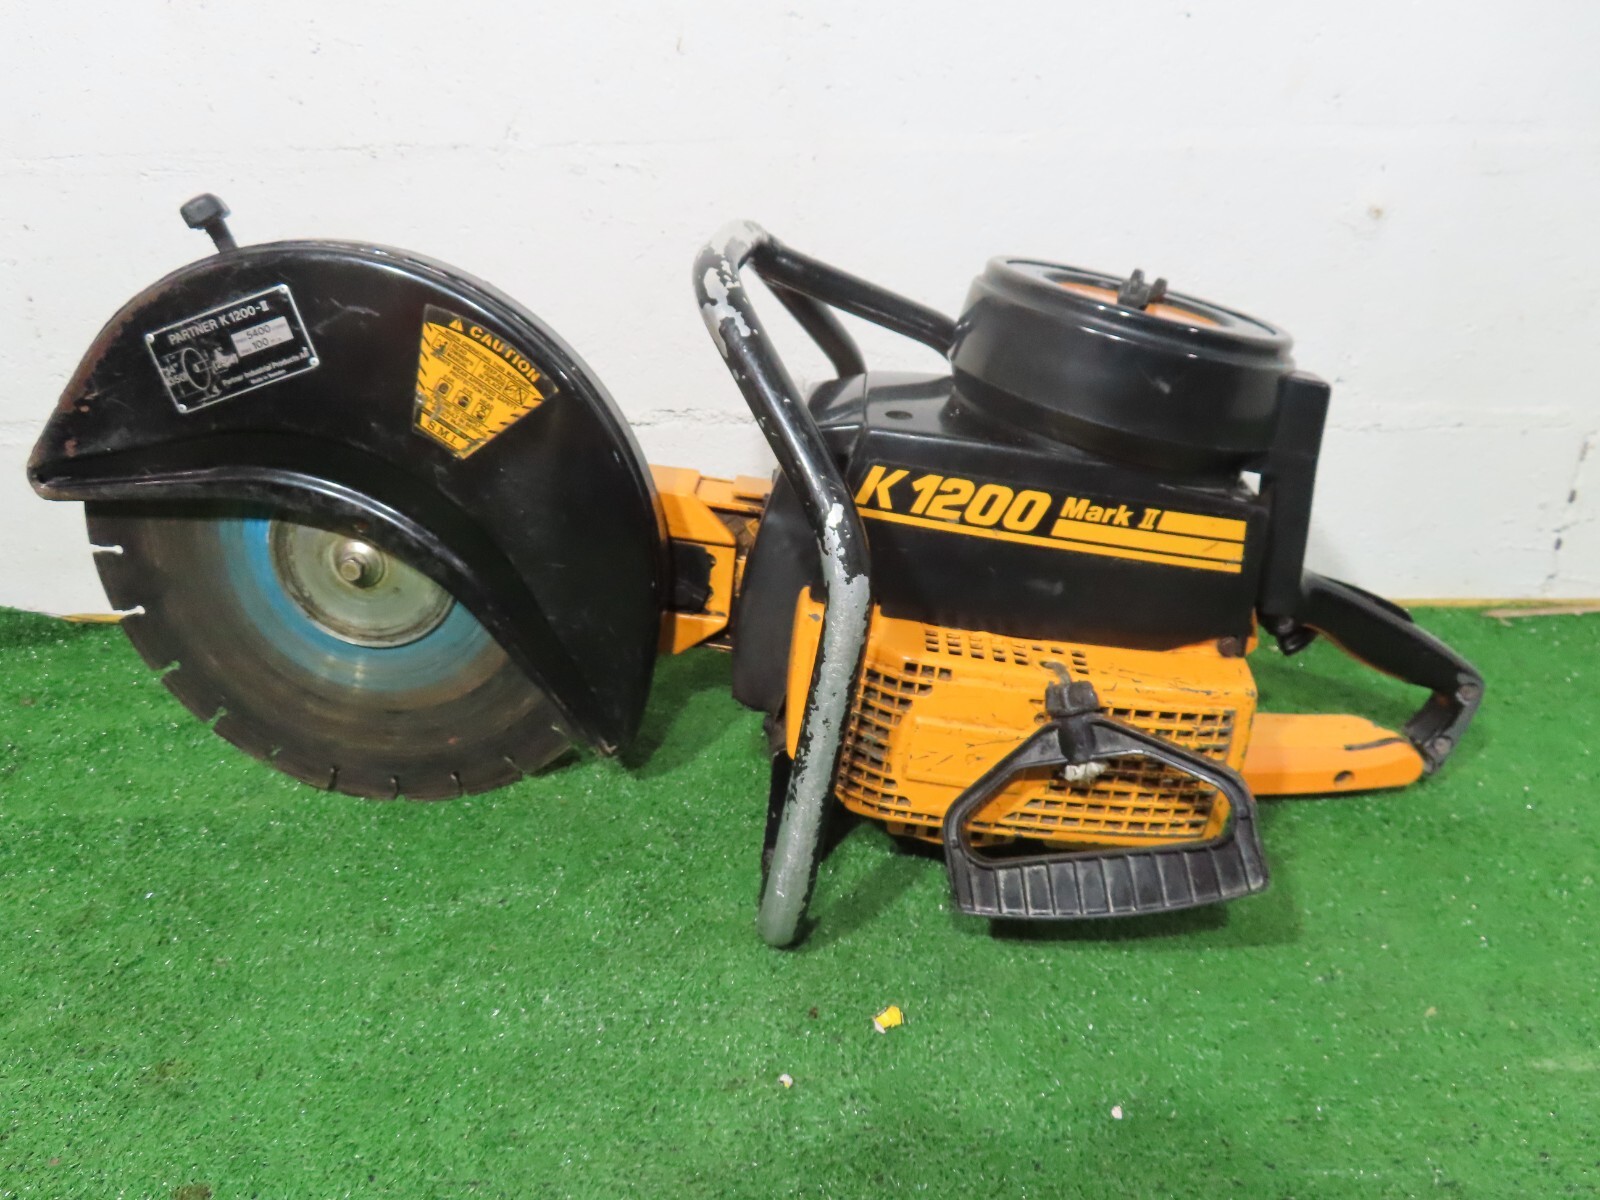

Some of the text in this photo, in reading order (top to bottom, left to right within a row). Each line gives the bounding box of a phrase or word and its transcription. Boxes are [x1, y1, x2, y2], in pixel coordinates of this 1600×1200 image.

[168, 320, 218, 345] PARTNER
[218, 313, 230, 326] K
[246, 323, 271, 339] 5400
[252, 337, 270, 350] 100
[451, 343, 467, 356] READ
[469, 325, 541, 382] CAUTION
[451, 365, 468, 378] WEAR
[484, 376, 502, 391] PLACE
[855, 465, 1051, 533] K 1200
[1059, 496, 1134, 527] Mark
